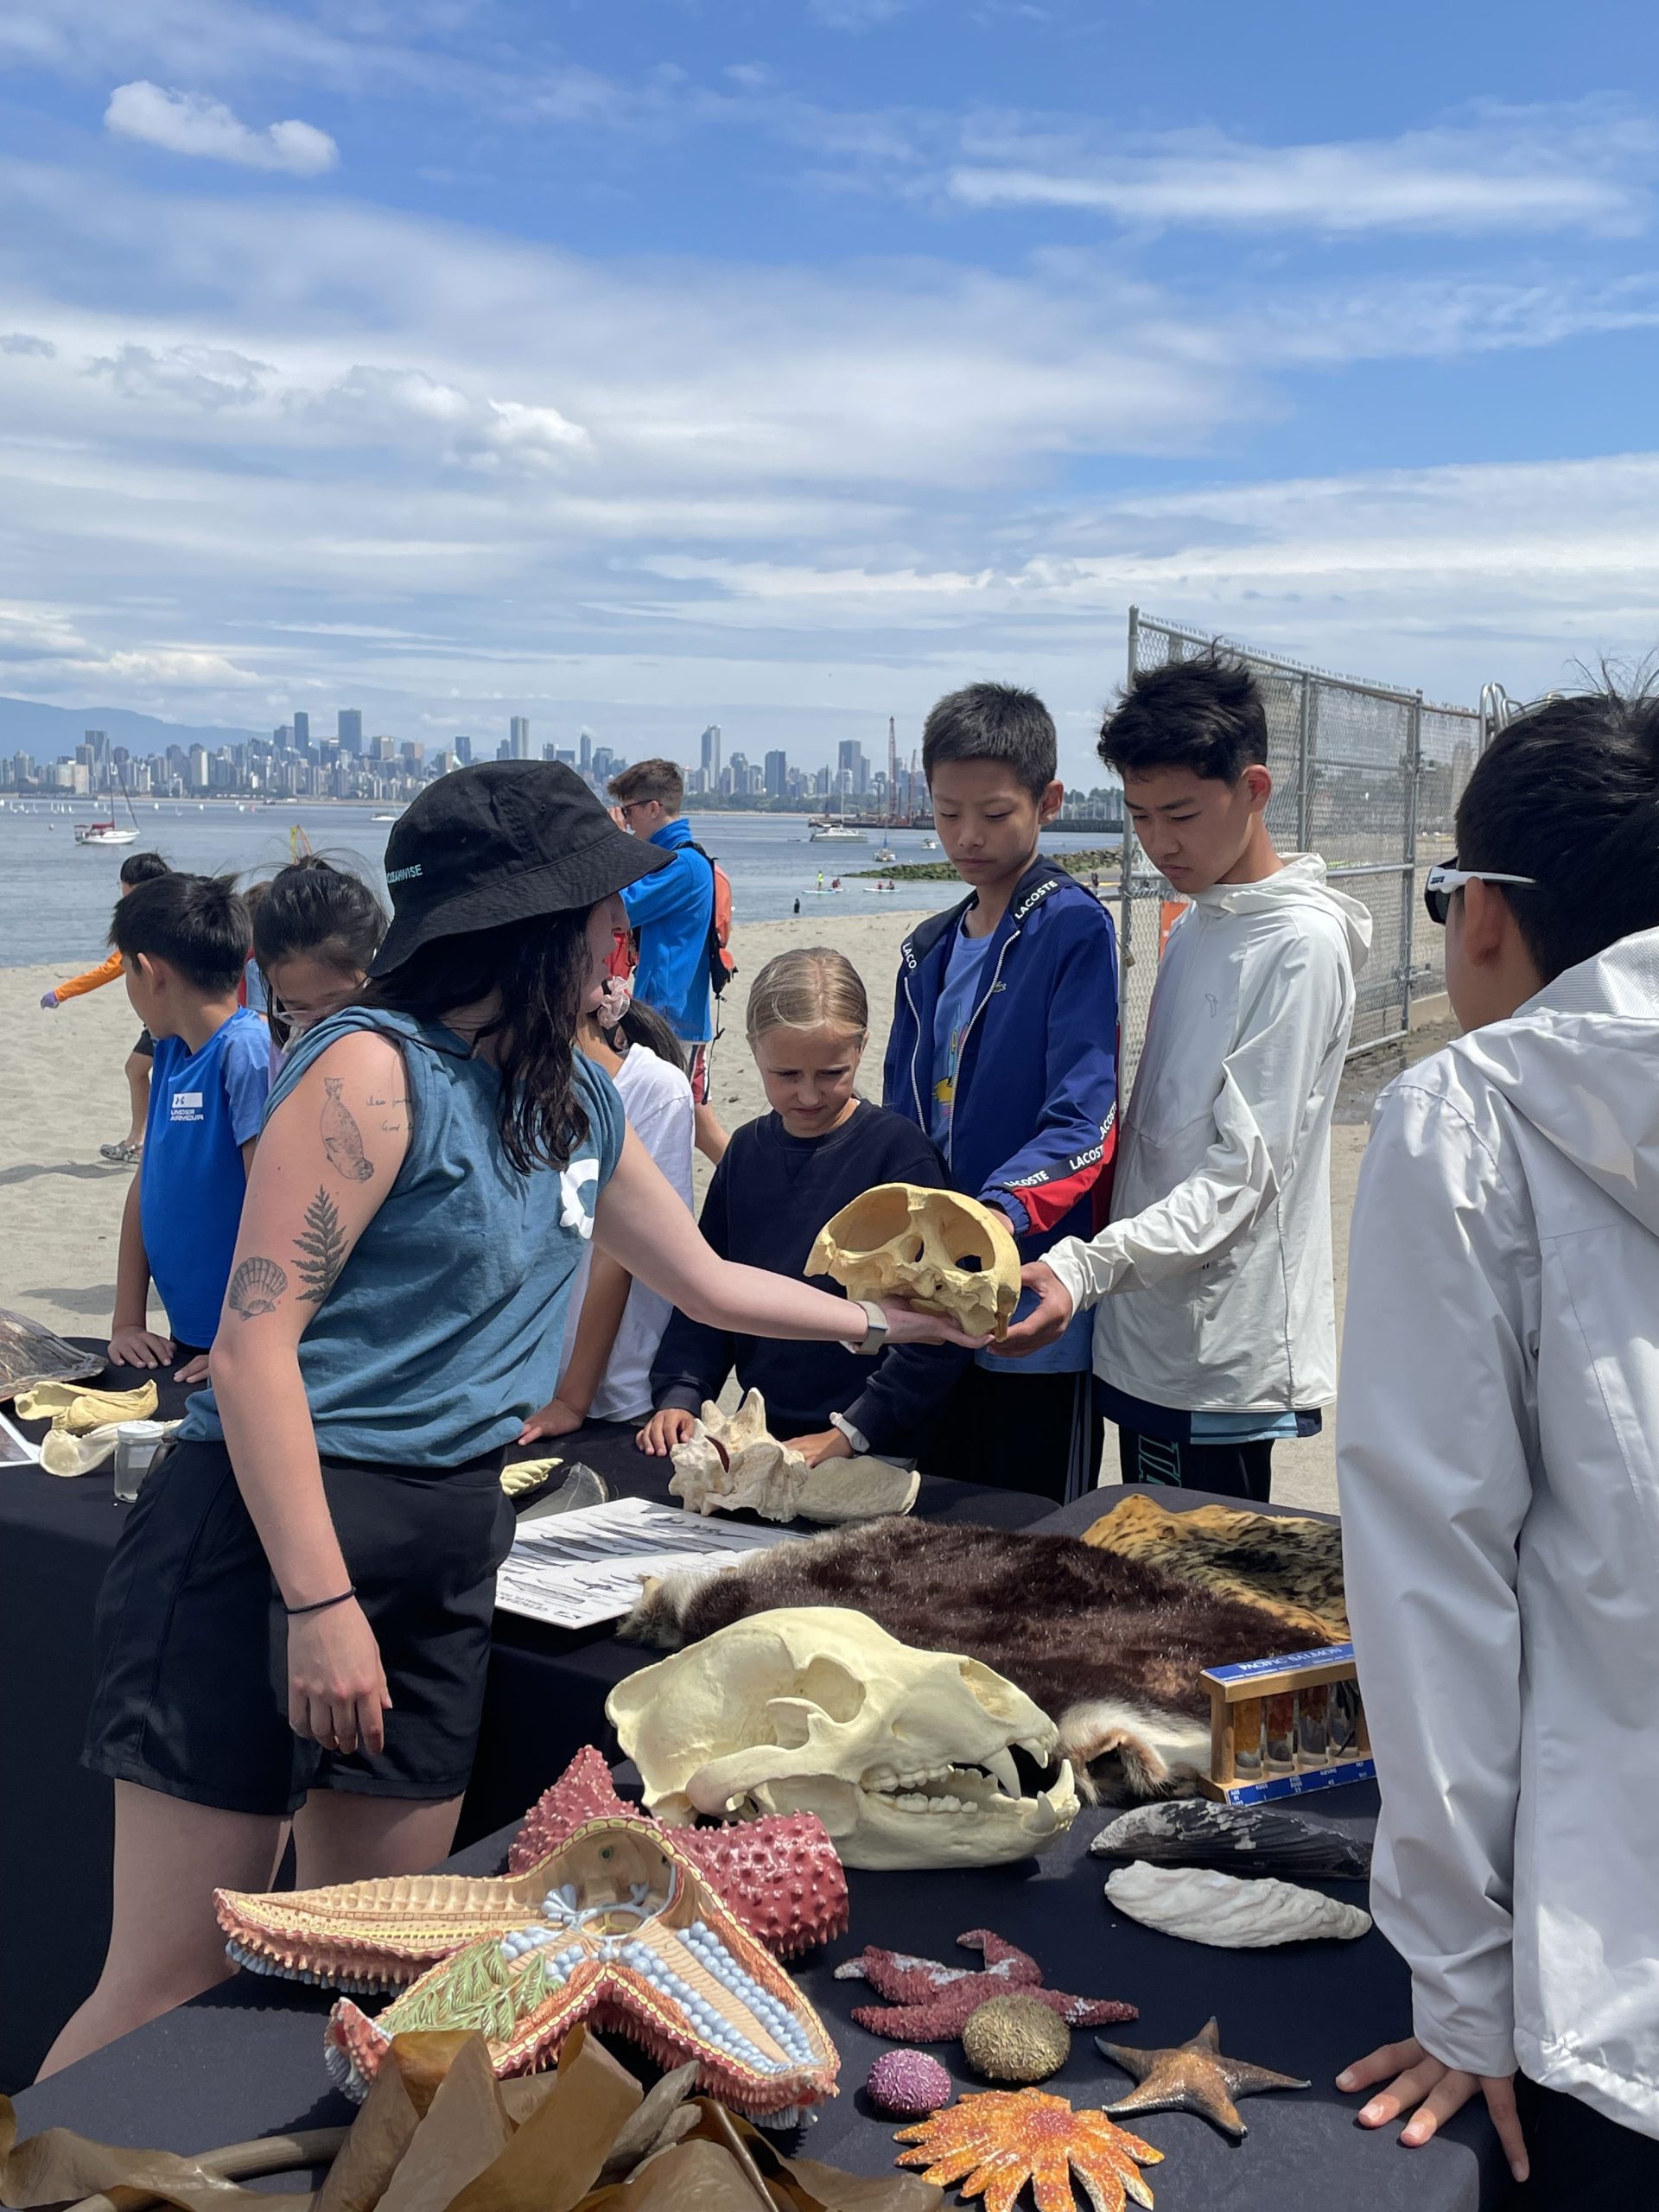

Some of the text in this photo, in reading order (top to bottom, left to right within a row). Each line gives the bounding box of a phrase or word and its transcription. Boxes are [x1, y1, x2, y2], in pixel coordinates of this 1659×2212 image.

[1014, 880, 1058, 919] LACOSTE
[902, 942, 917, 969] LACO
[1069, 1144, 1104, 1171] LACOST
[1237, 1657, 1287, 1671] PACIFIC
[1287, 1646, 1344, 1662] SALMON
